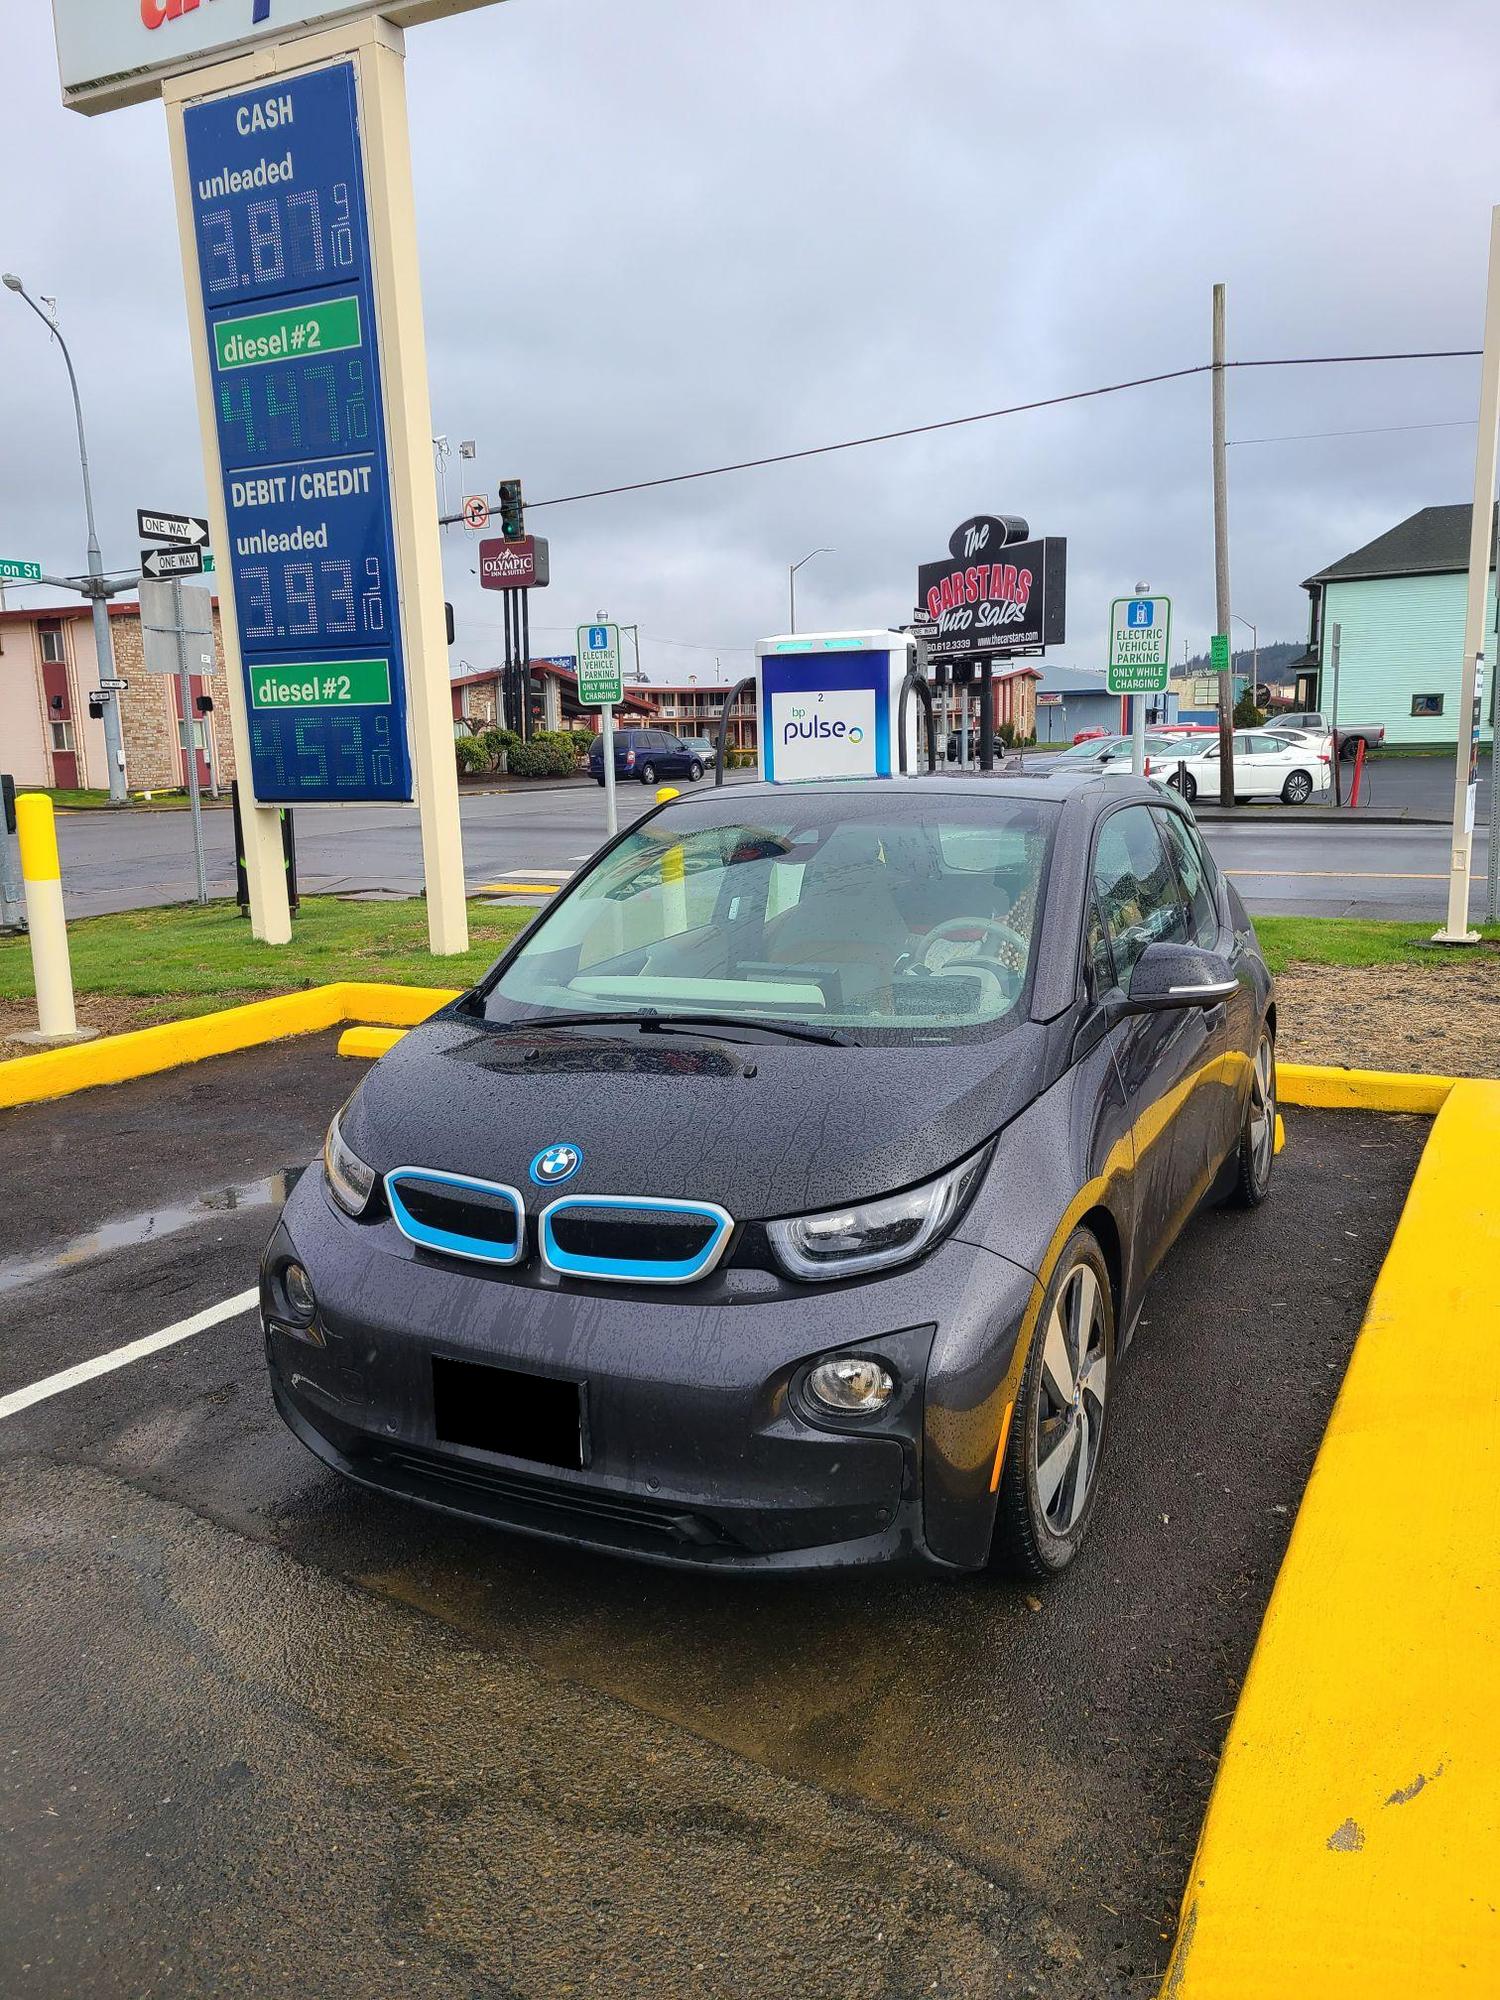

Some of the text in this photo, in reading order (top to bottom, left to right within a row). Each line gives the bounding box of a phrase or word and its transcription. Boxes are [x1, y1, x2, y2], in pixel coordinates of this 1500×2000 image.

[236, 94, 294, 136] CASH
[198, 151, 294, 200] unleaded
[201, 189, 326, 295] 3.87
[223, 320, 322, 363] diesel #2
[219, 363, 339, 453] 4.47
[231, 477, 287, 508] DEBIT
[299, 466, 373, 500] CREDIT
[145, 518, 189, 537] ONE WAY
[236, 522, 328, 555] unleaded
[963, 523, 990, 558] The
[159, 555, 178, 569] ONE
[178, 553, 196, 567] WAY
[484, 557, 532, 572] OLYMPIC
[24, 563, 38, 577] St
[507, 568, 526, 576] SUITES
[240, 559, 357, 639] 3.93
[926, 563, 1033, 621] CARSTARS
[937, 600, 1027, 634] Auto Sales
[926, 630, 1039, 653] 60.612.3339 www.thecarstars.com
[1116, 628, 1163, 641] ELECTRIC
[1118, 640, 1160, 652] VEHICLE
[582, 650, 615, 661] ELECTRIC
[1117, 652, 1160, 664] PARKING
[584, 659, 614, 670] VEHICLE
[1112, 666, 1164, 678] ONLY WHILE
[584, 669, 615, 680] PARKING
[258, 674, 352, 703] diesel #2
[582, 681, 619, 691] ONLY WHILE
[1115, 679, 1160, 689] CHARGING
[584, 691, 617, 700] CHARGING
[818, 693, 825, 702] 2
[791, 706, 806, 719] bp
[784, 714, 846, 746] pulse
[251, 715, 367, 788] 4.53
